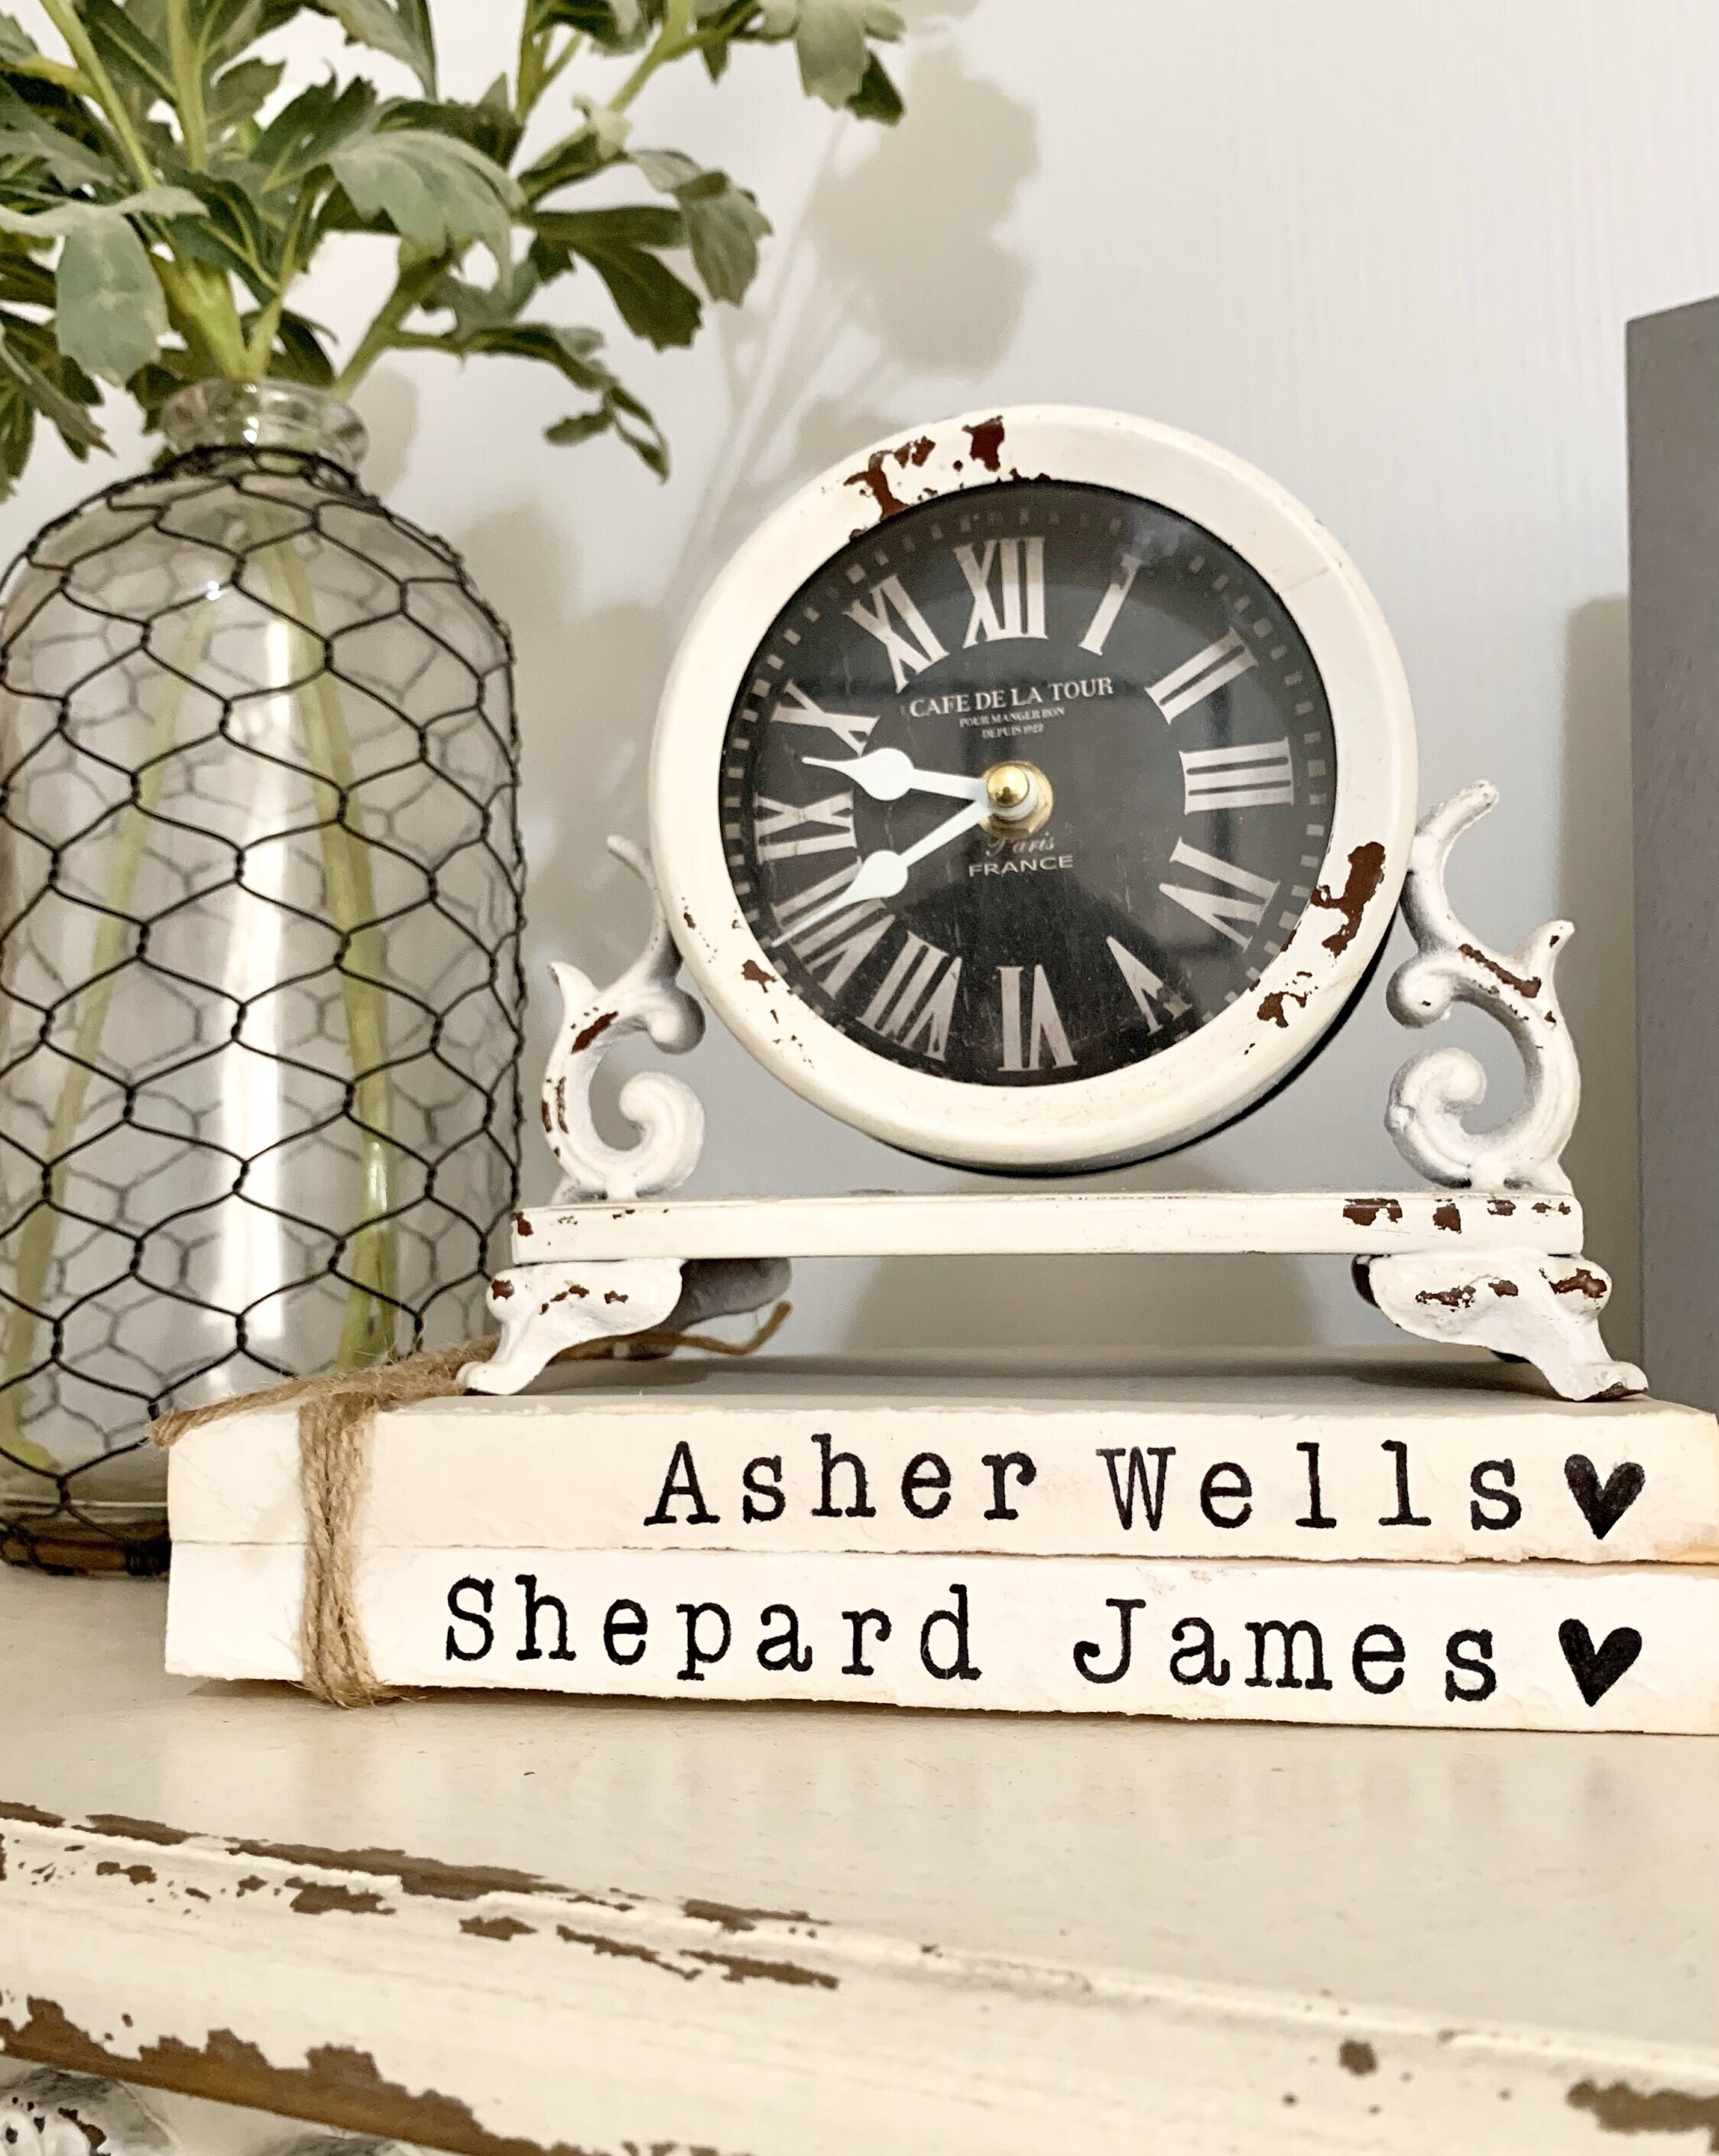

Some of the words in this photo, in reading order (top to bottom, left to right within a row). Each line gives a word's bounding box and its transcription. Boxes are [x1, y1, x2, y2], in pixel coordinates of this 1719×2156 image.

[842, 573, 950, 693] XI
[953, 536, 1049, 649] XII
[1078, 553, 1143, 656] I
[770, 680, 880, 755] X
[909, 694, 971, 718] CAFE
[975, 689, 1008, 711] DE
[1010, 686, 1043, 706] LA
[1047, 676, 1114, 702] TOUR
[959, 715, 990, 728] POUR
[1144, 627, 1258, 725] II
[1179, 736, 1293, 815] III
[754, 789, 858, 866] IX
[968, 854, 1074, 877] FRANCE
[1158, 835, 1281, 954] IV
[855, 929, 963, 1062] VII
[996, 963, 1078, 1072] VI
[1106, 936, 1193, 1035] V
[644, 1433, 1037, 1527] Asher
[1095, 1439, 1523, 1532] Wells
[446, 1574, 982, 1681] Shepard
[1073, 1597, 1497, 1702] James
